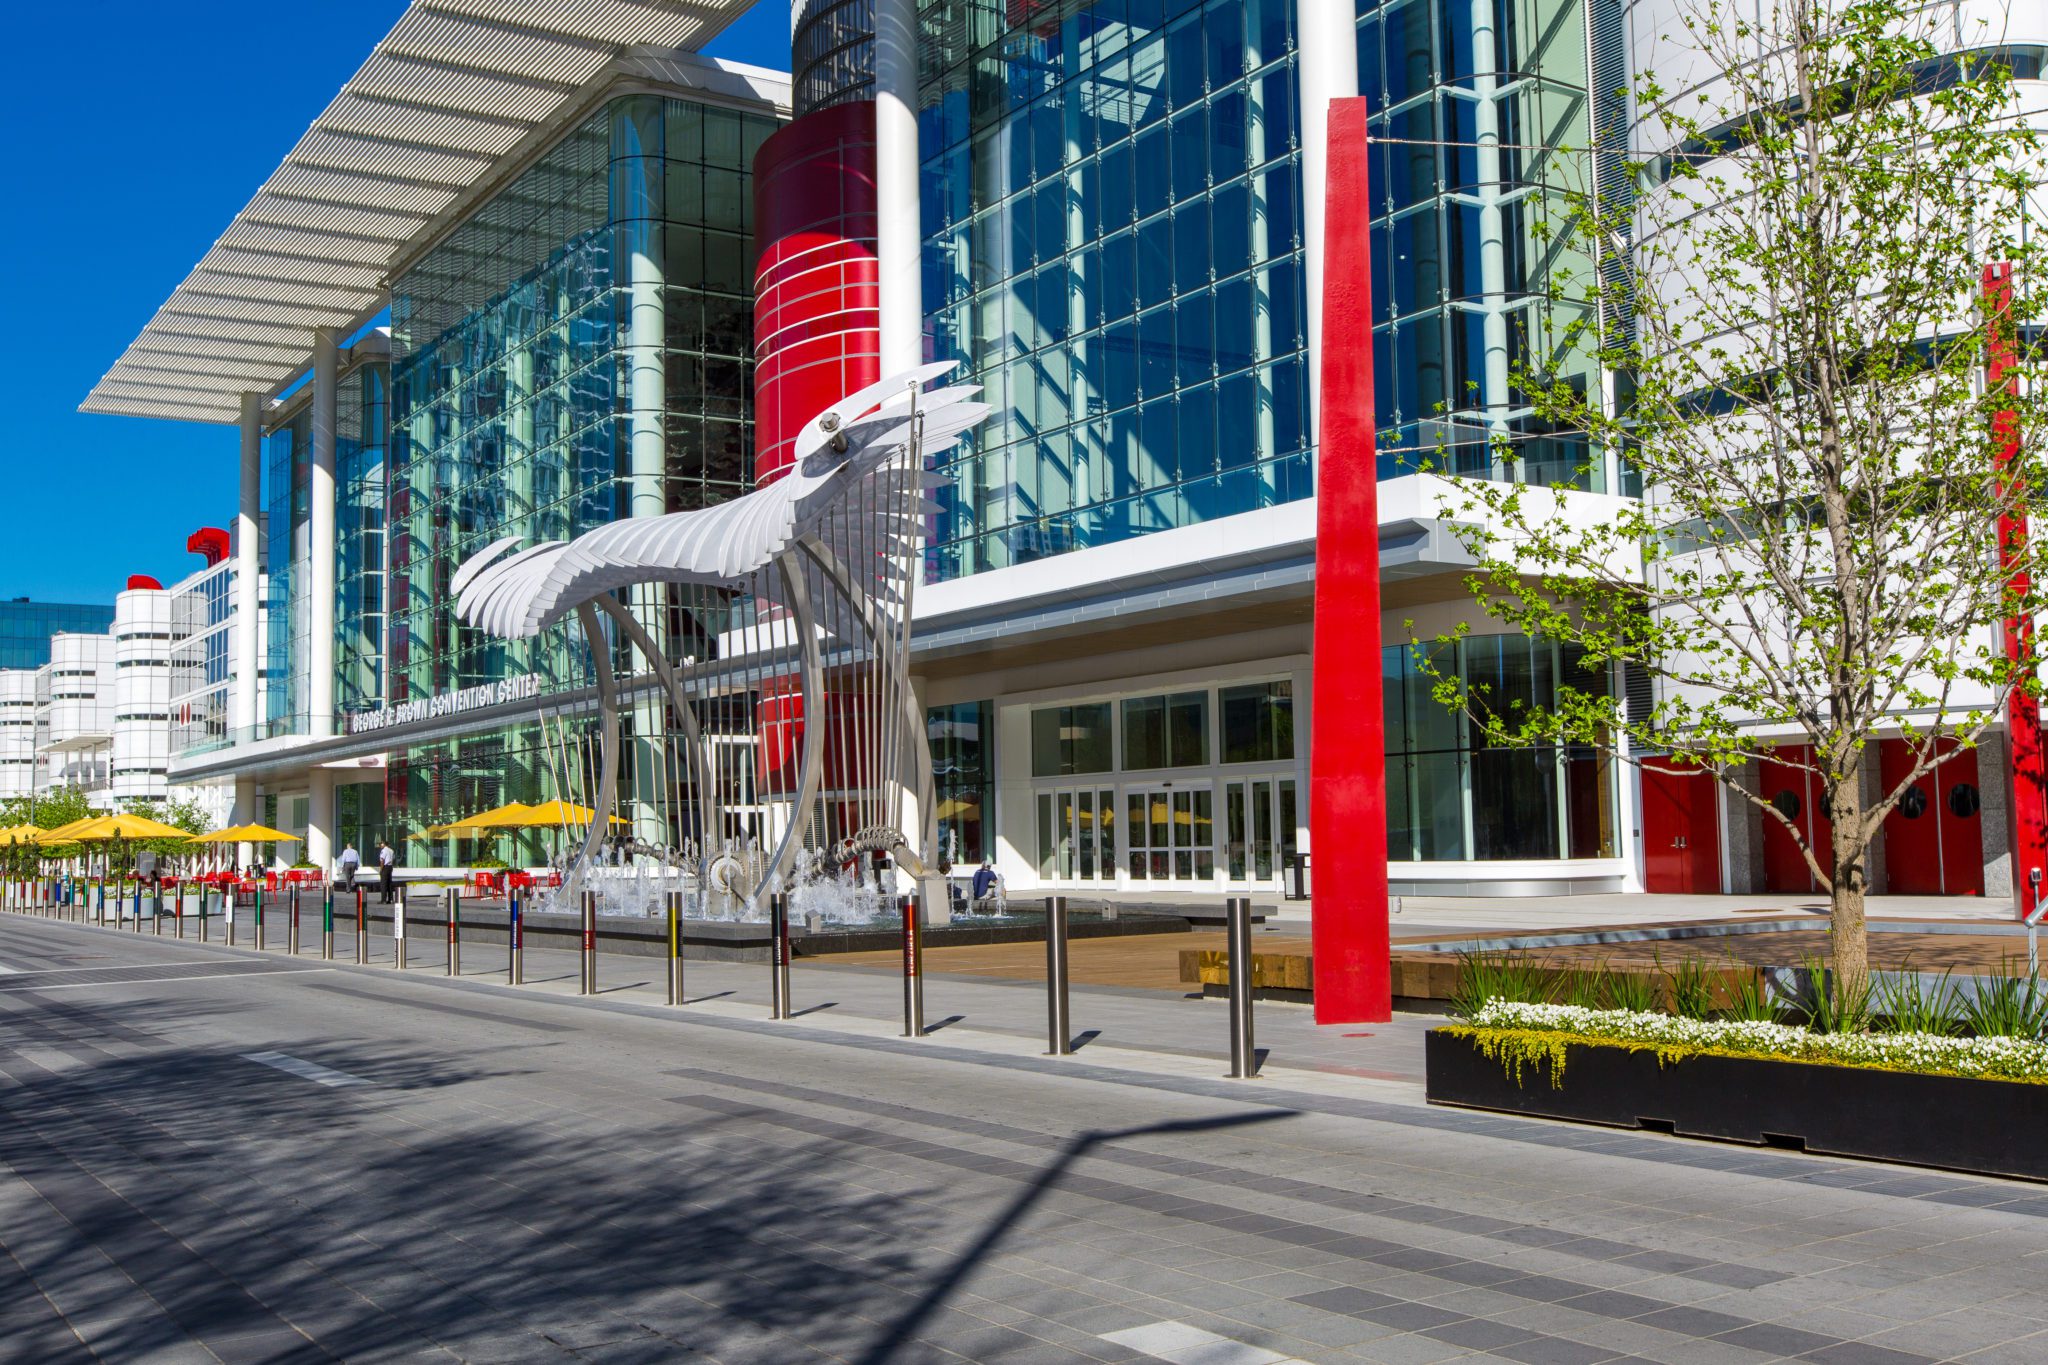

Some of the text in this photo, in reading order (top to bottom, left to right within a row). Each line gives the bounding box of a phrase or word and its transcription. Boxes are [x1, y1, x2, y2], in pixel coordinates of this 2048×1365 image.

[353, 708, 384, 733] GEORGE
[397, 699, 427, 723] BROWN
[430, 683, 493, 717] CONVENTION
[498, 673, 539, 703] CENTER
